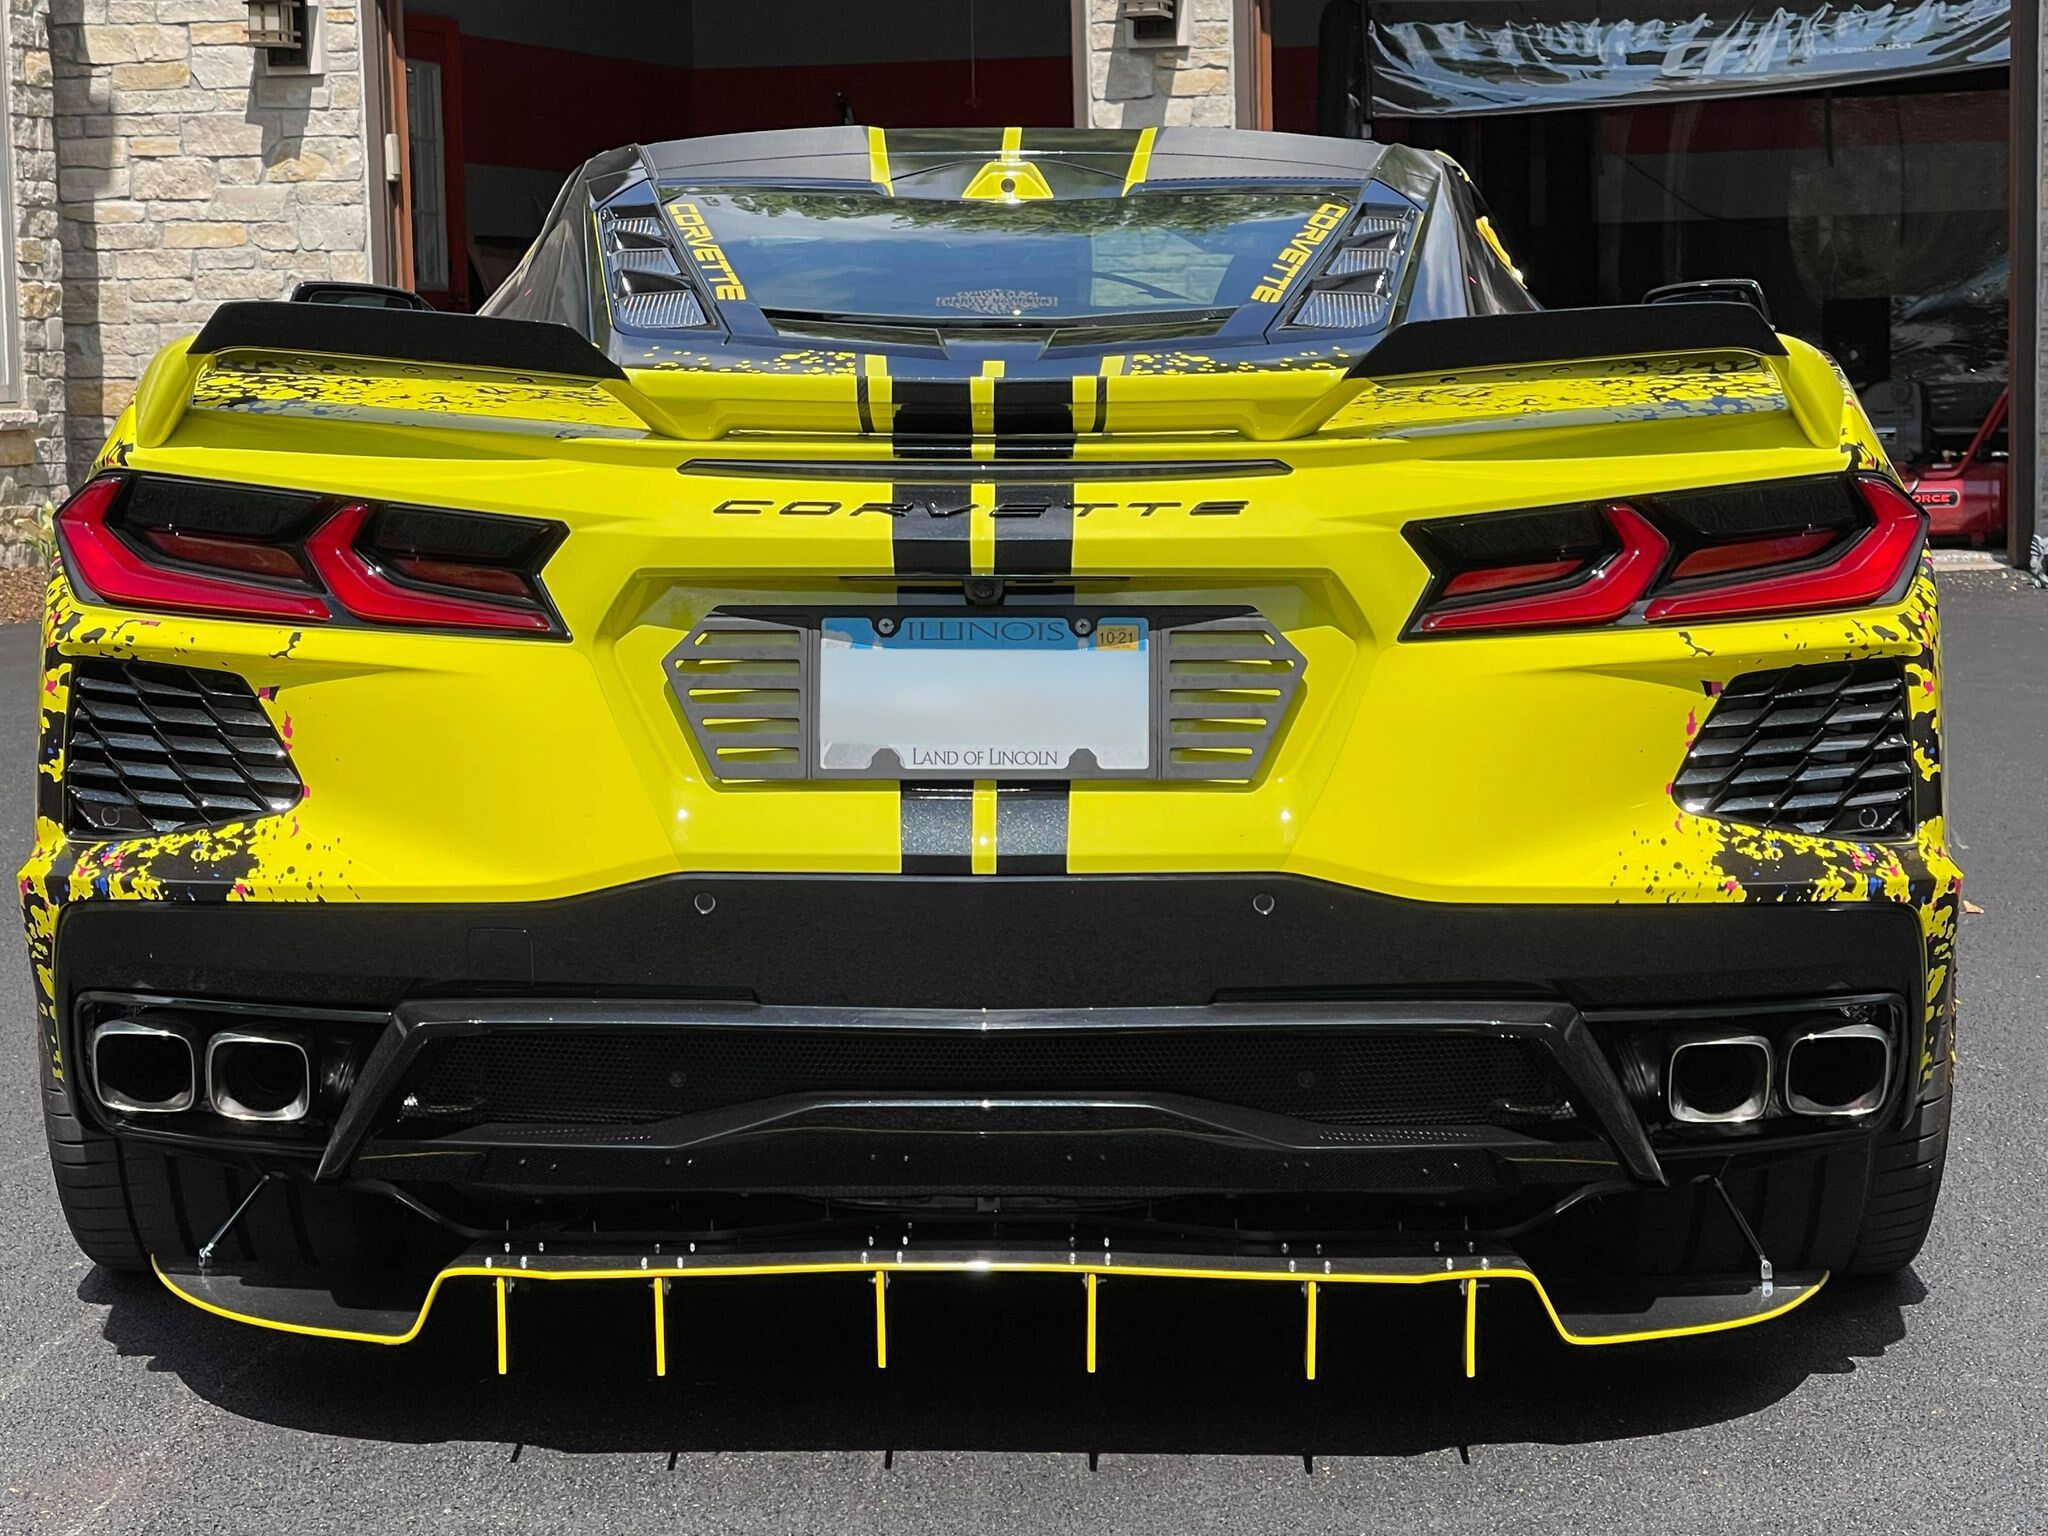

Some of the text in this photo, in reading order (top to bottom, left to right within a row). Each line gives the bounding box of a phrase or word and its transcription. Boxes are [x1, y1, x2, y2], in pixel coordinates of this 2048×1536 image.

[668, 203, 747, 301] CORVETTE
[1250, 203, 1348, 303] CORVETTE
[713, 499, 1250, 518] CORVETTE
[908, 621, 1065, 641] ILLINOIS
[1100, 631, 1133, 645] 10-21
[913, 747, 1058, 765] LAND OF LINCOLN
